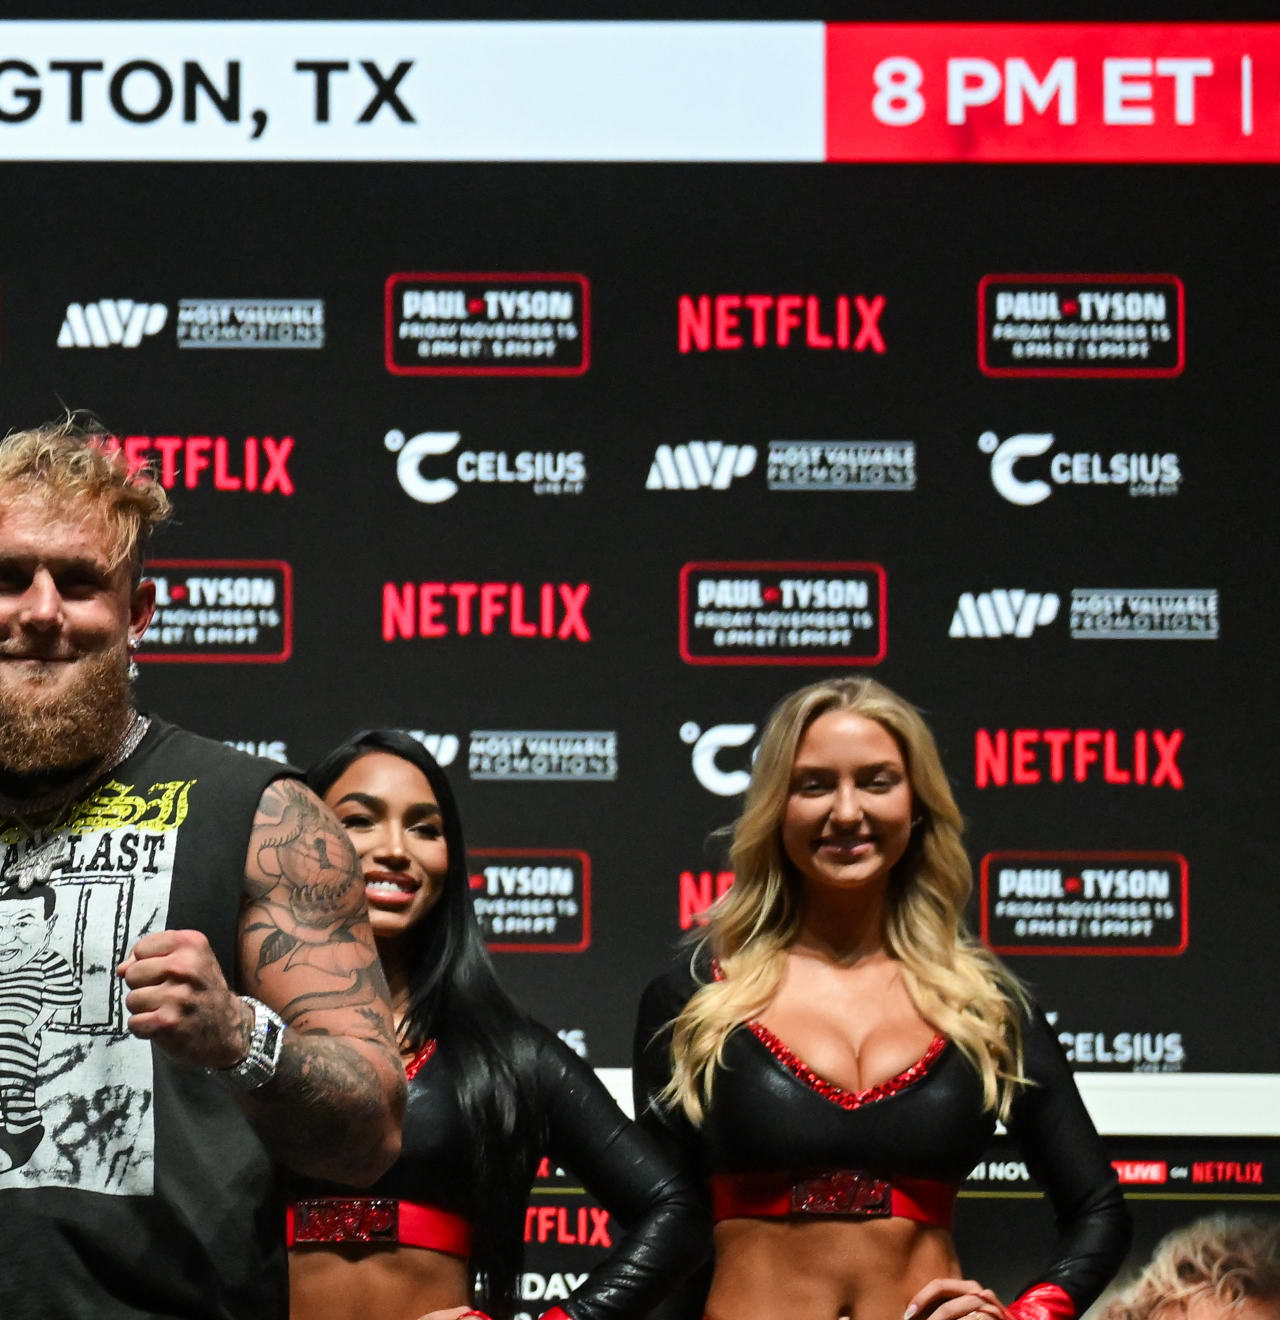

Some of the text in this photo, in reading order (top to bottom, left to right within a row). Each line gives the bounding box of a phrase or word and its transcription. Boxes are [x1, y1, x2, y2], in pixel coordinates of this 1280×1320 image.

[296, 62, 415, 122] TX
[872, 57, 1213, 125] 8 PM ET
[404, 292, 572, 319] PAUL TYSON
[997, 293, 1165, 320] PAUL TYSON
[680, 296, 884, 351] NETFLIX
[103, 435, 295, 497] ETFLIX
[457, 451, 585, 481] CELSIUS
[1051, 452, 1180, 482] CELSIUS
[187, 578, 274, 605] TYSON
[699, 580, 867, 608] PAUL TYSON
[384, 584, 588, 639] NETFLIX
[977, 731, 1182, 786] NETFLIX
[66, 832, 166, 875] LAST
[484, 867, 572, 895] TYSON
[999, 870, 1169, 898] PAUL TYSON
[1125, 1163, 1161, 1181] LIVE
[1192, 1161, 1263, 1184] NETFLIX
